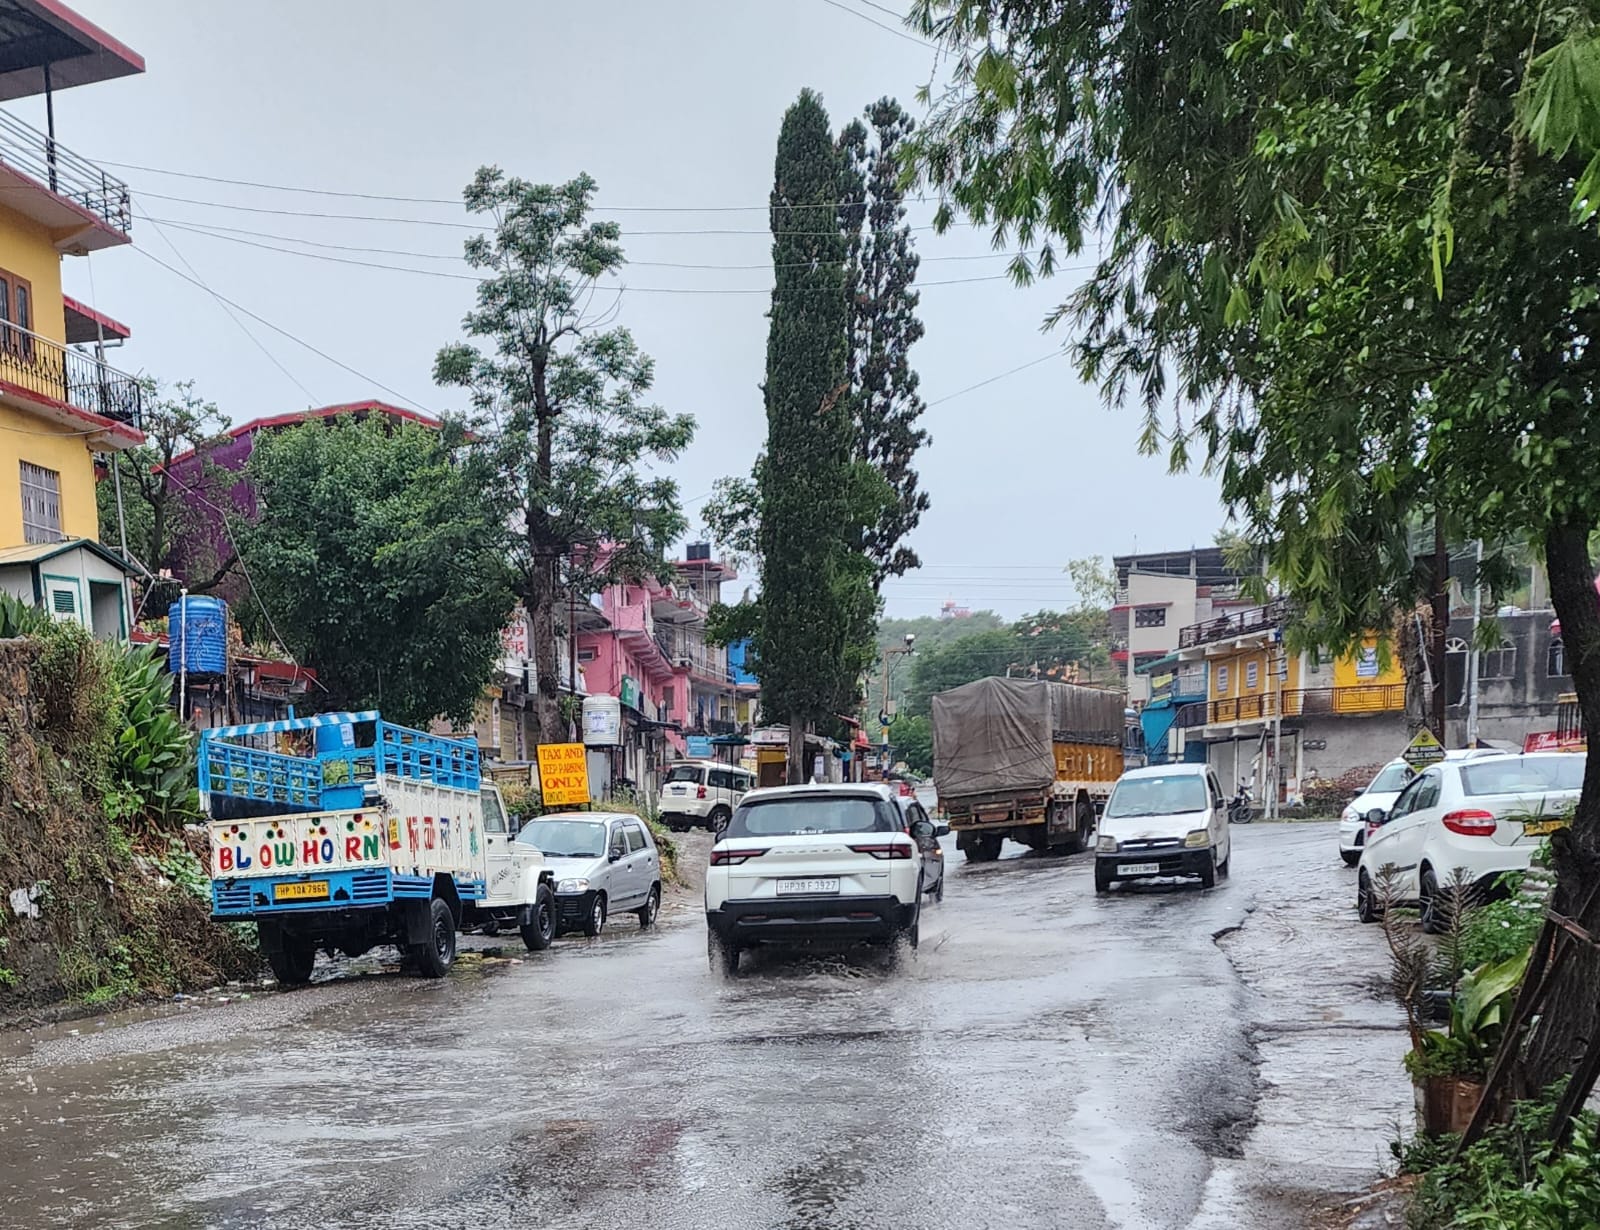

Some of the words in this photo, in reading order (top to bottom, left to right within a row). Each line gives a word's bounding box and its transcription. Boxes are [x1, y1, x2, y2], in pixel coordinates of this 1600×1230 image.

[540, 748, 561, 760] TAXI
[564, 747, 583, 759] AND
[543, 763, 557, 775] JEEP
[544, 776, 585, 789] ONLY
